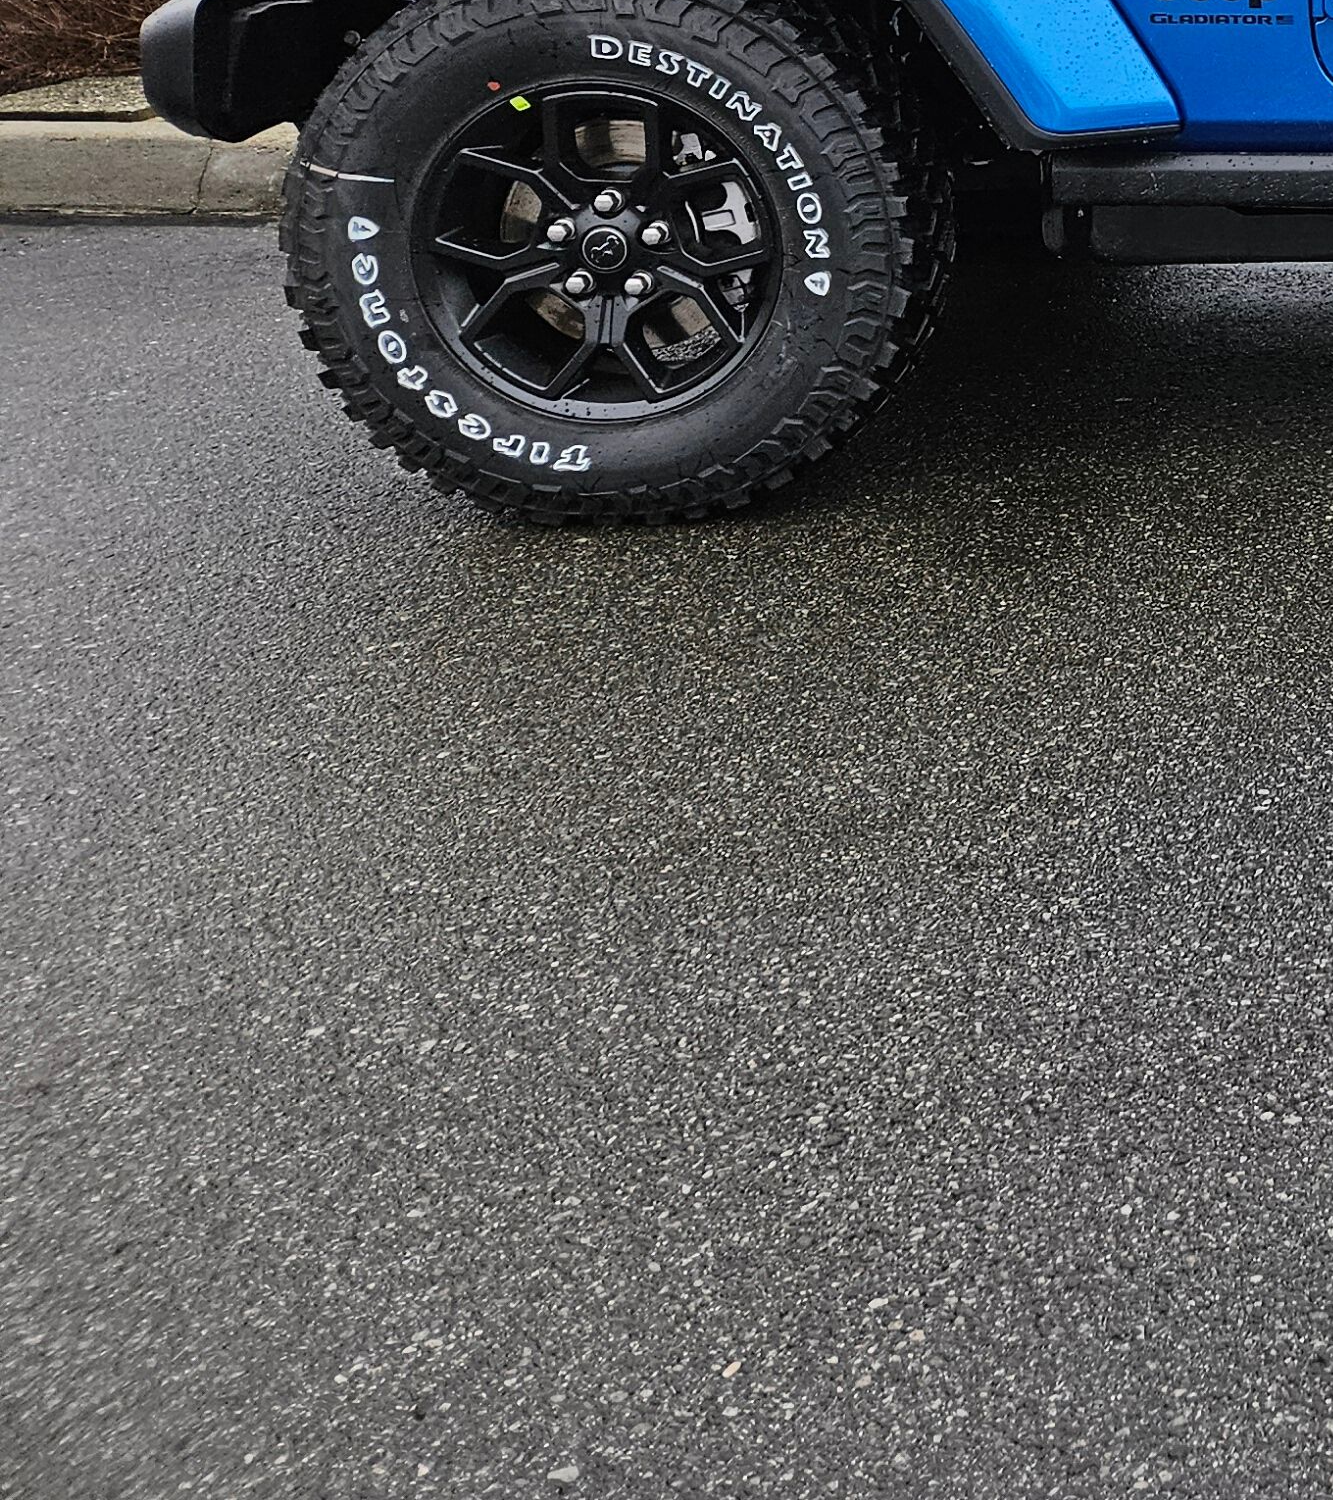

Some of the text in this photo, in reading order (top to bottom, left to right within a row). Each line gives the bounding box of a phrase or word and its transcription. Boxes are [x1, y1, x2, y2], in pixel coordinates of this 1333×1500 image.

[1150, 13, 1273, 26] GLADIATOR
[587, 33, 832, 259] DESTINATION
[351, 252, 593, 474] Firestone
